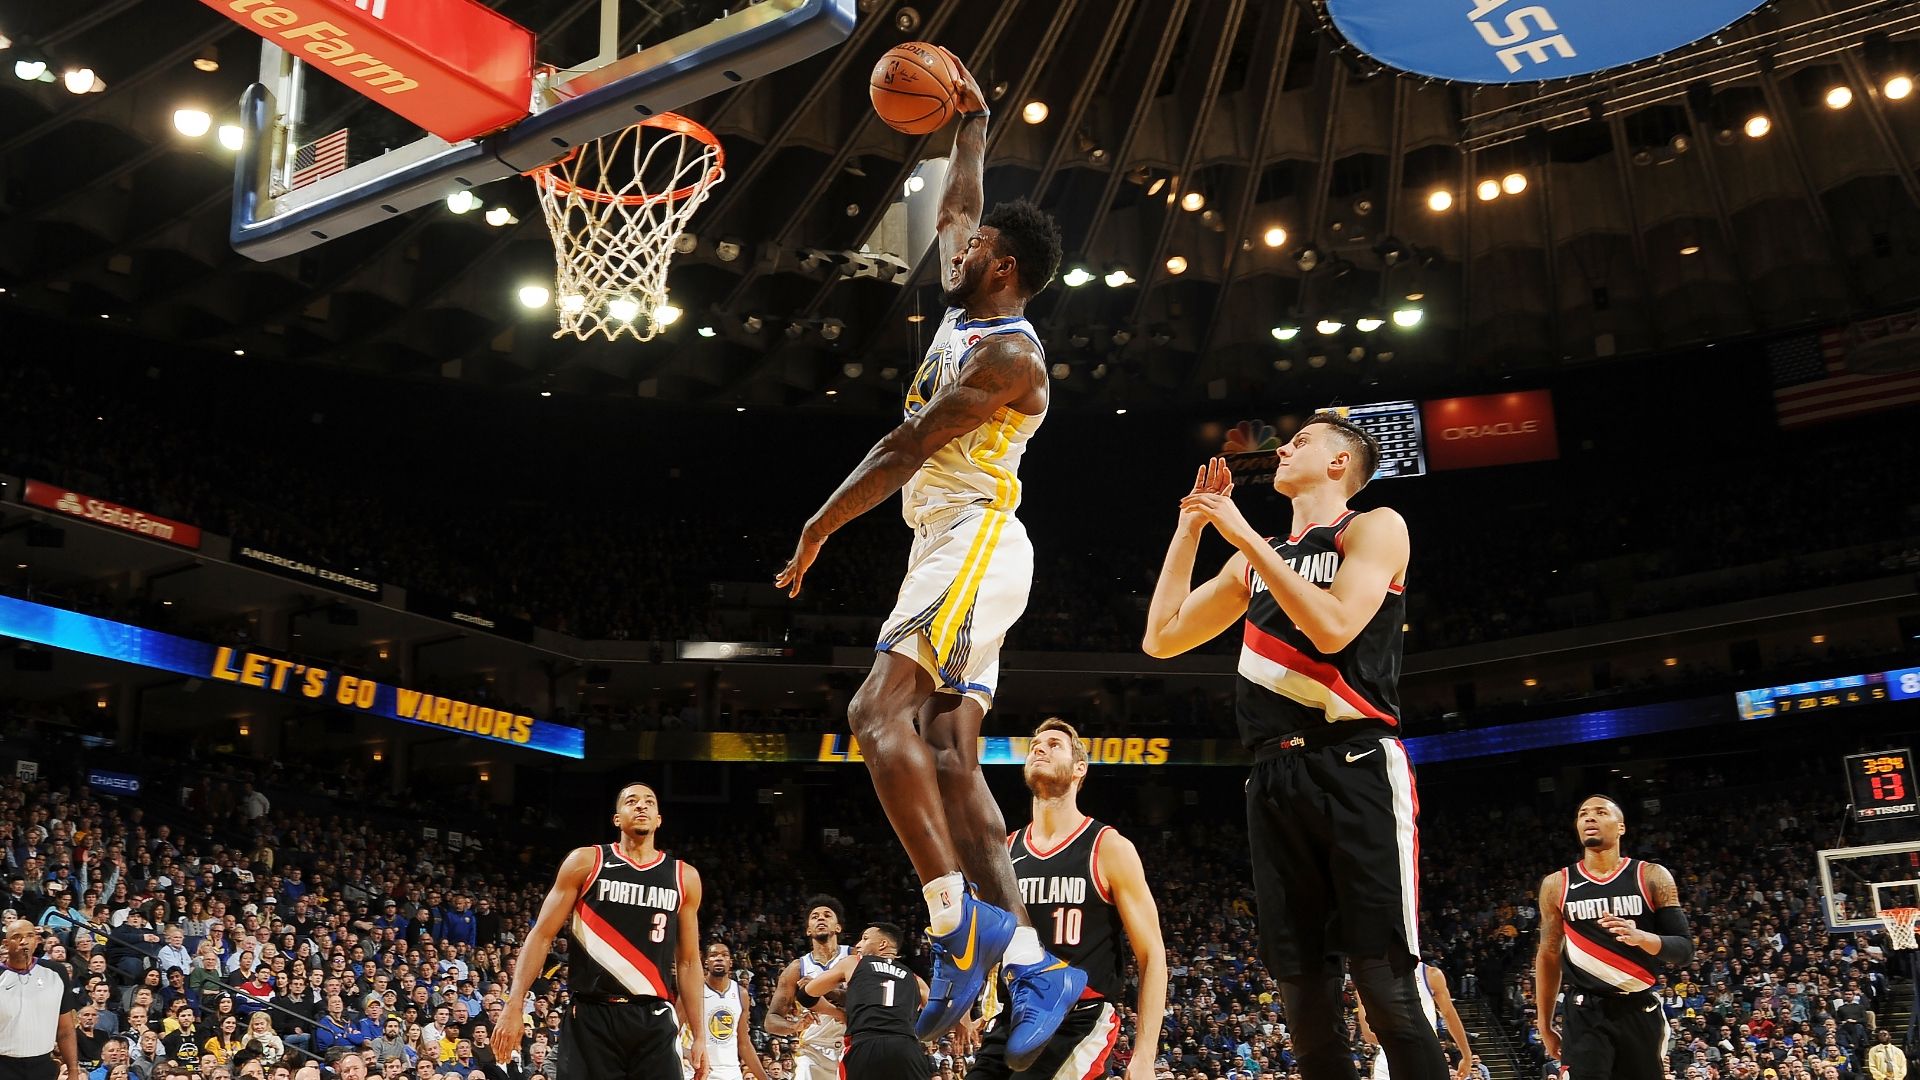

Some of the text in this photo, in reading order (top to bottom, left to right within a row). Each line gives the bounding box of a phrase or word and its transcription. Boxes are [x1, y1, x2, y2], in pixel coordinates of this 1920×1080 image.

[1441, 420, 1539, 441] ORACLE
[241, 547, 379, 593] AMERICAN EXPRESS
[211, 646, 535, 744] LET'S GO WARRIORS
[1900, 673, 1920, 694] 8
[90, 774, 129, 789] CHASE
[1871, 773, 1905, 800] 13
[1875, 803, 1916, 815] TISSOT
[599, 879, 678, 912] PORTLAND
[1018, 876, 1087, 905] RTLAND
[651, 912, 668, 943] 3
[1052, 907, 1083, 946] 10
[869, 961, 908, 979] TURNER
[880, 979, 896, 1007] 1
